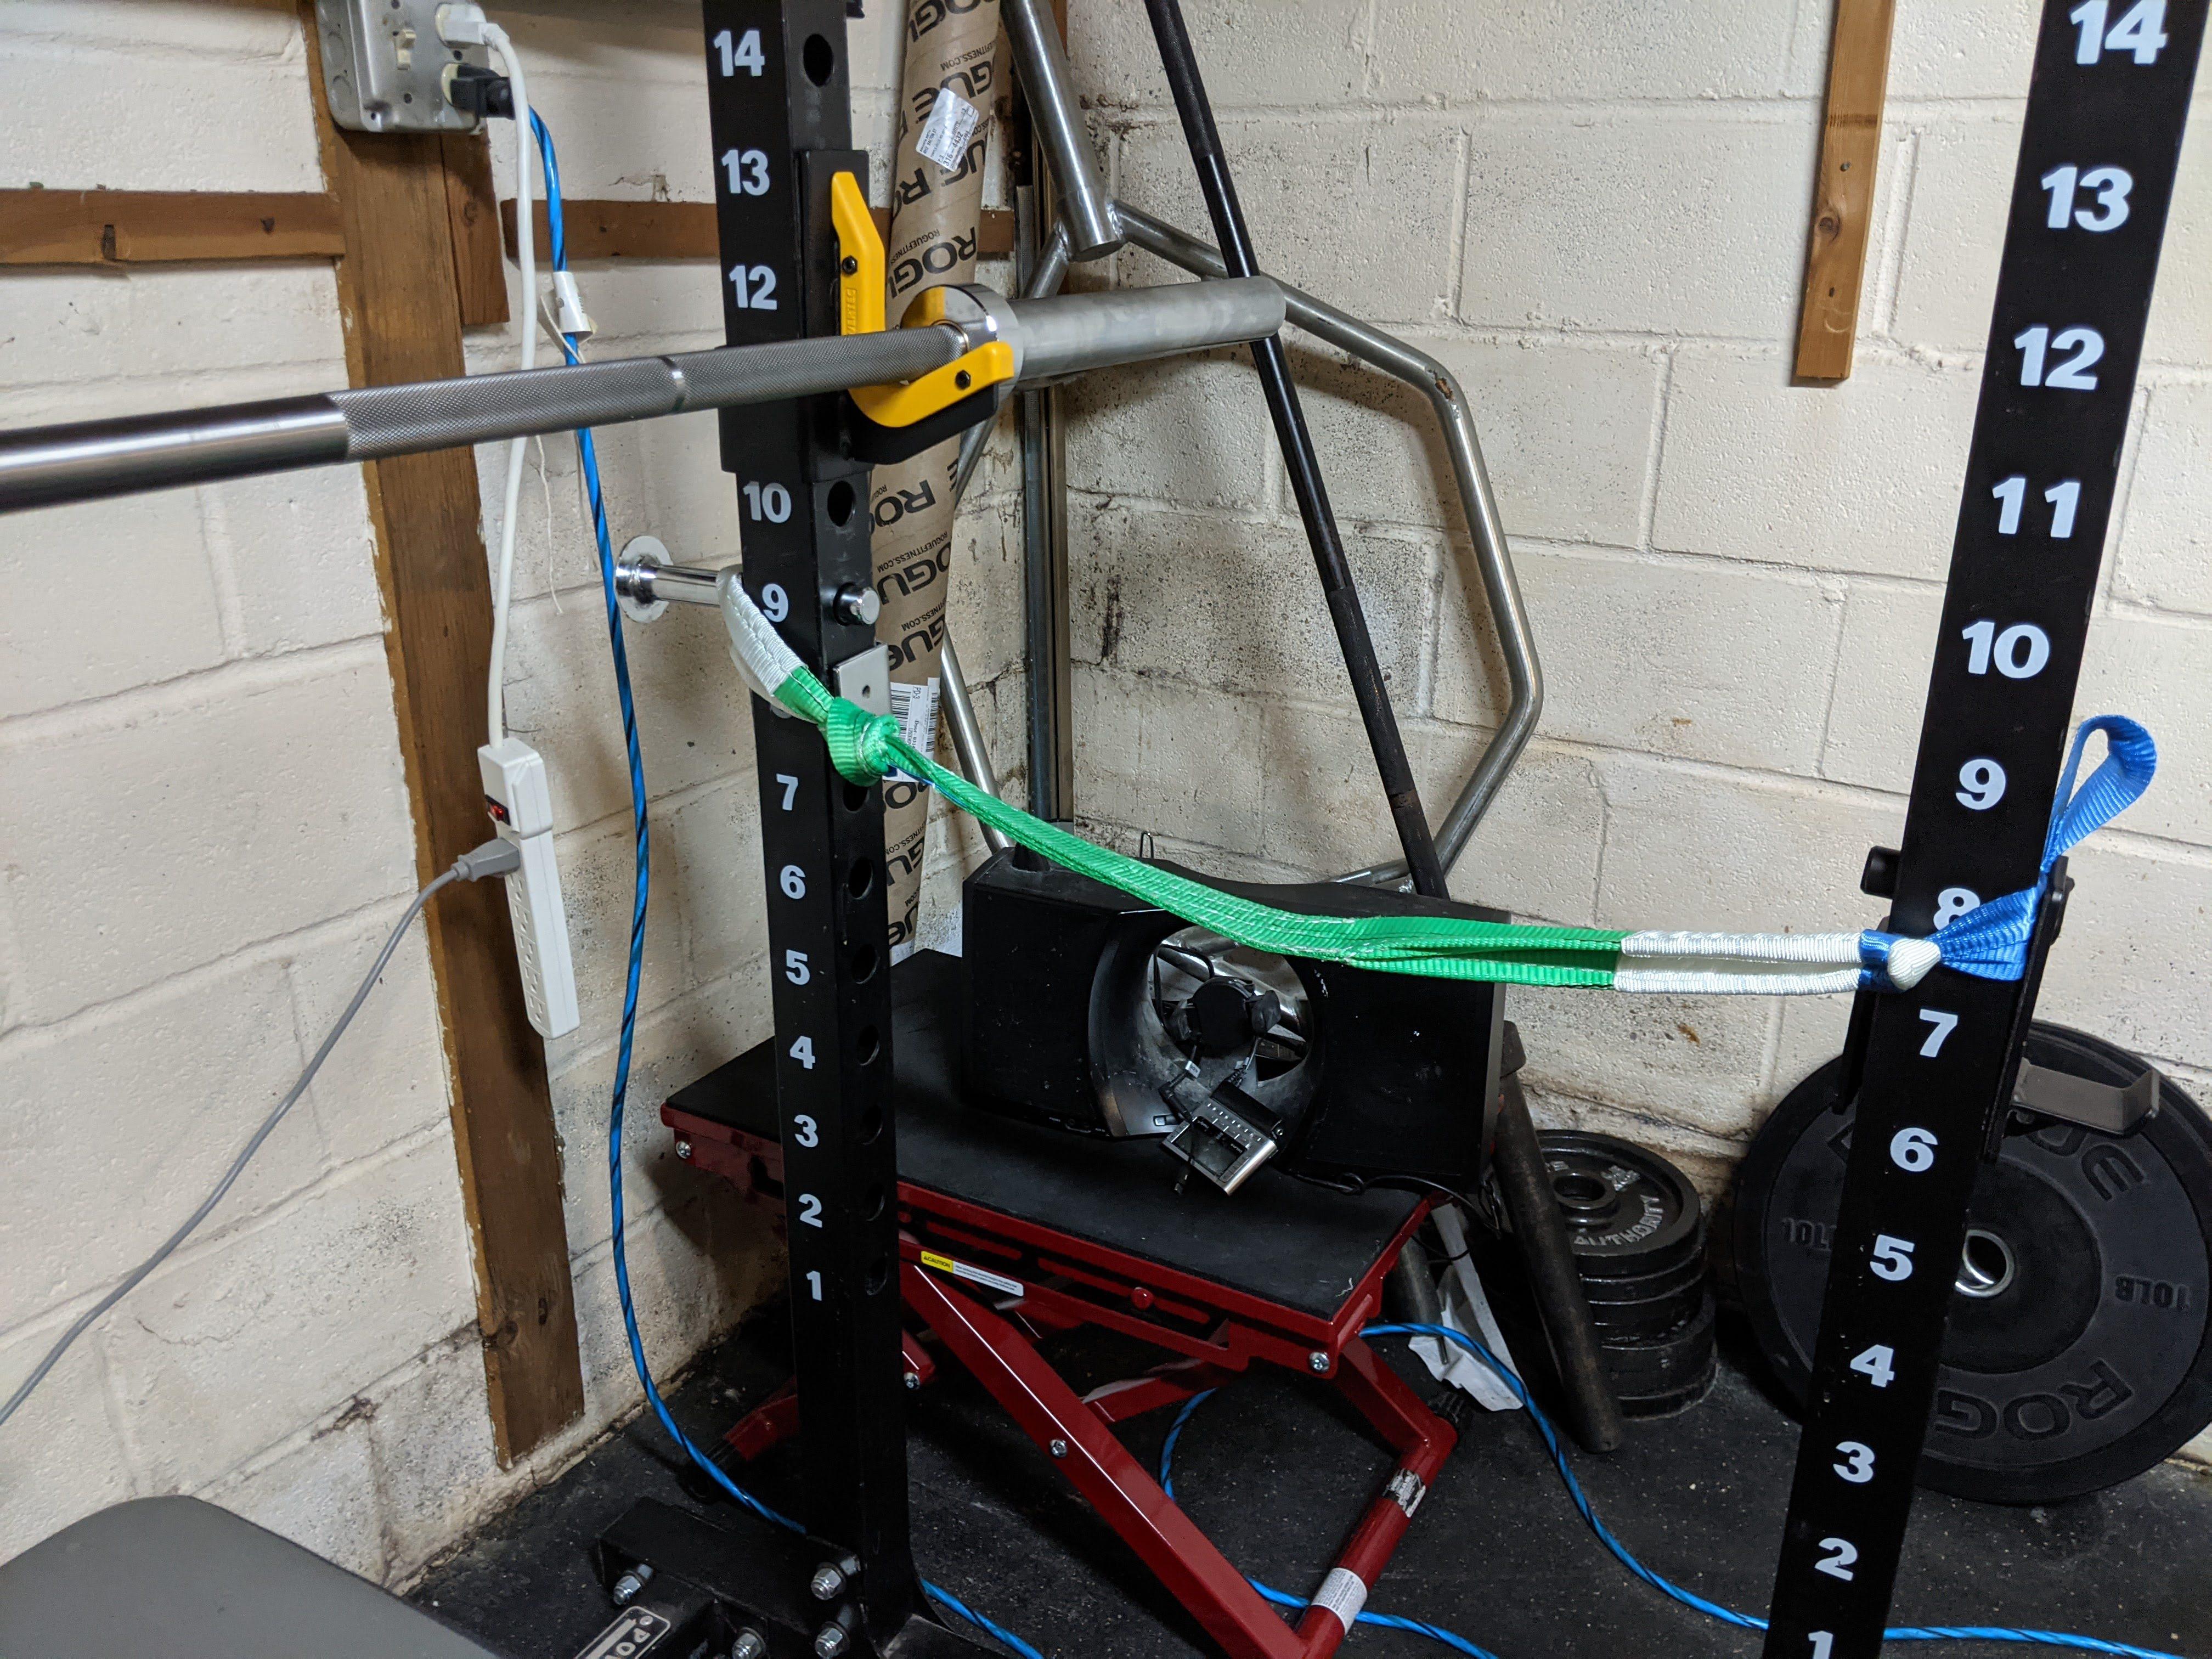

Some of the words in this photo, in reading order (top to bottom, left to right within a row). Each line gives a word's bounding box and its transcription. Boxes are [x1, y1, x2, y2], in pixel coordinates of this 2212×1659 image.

[714, 30, 765, 77] 14
[2070, 0, 2168, 64] 14
[721, 149, 770, 196] 13
[2041, 166, 2134, 232] 13
[729, 265, 777, 310] 12
[2014, 327, 2104, 390] 12
[743, 481, 792, 523] 10
[1992, 477, 2080, 538] 11
[761, 583, 789, 623] 9
[1962, 620, 2050, 679] 10
[776, 774, 799, 811] 7
[1955, 759, 2006, 810] 9
[780, 865, 806, 899] 6
[1933, 888, 1981, 931] 8
[785, 949, 810, 985] 5
[789, 1035, 816, 1070] 4
[1919, 1009, 1958, 1058] 7
[793, 1114, 819, 1148] 3
[1890, 1127, 1938, 1172] 6
[798, 1194, 822, 1228] 2
[1870, 1234, 1915, 1281] 5
[806, 1271, 822, 1301] 1
[1850, 1344, 1895, 1387] 4
[1833, 1441, 1875, 1483] 3
[1815, 1538, 1858, 1581] 2
[1808, 1630, 1833, 1659] 1
